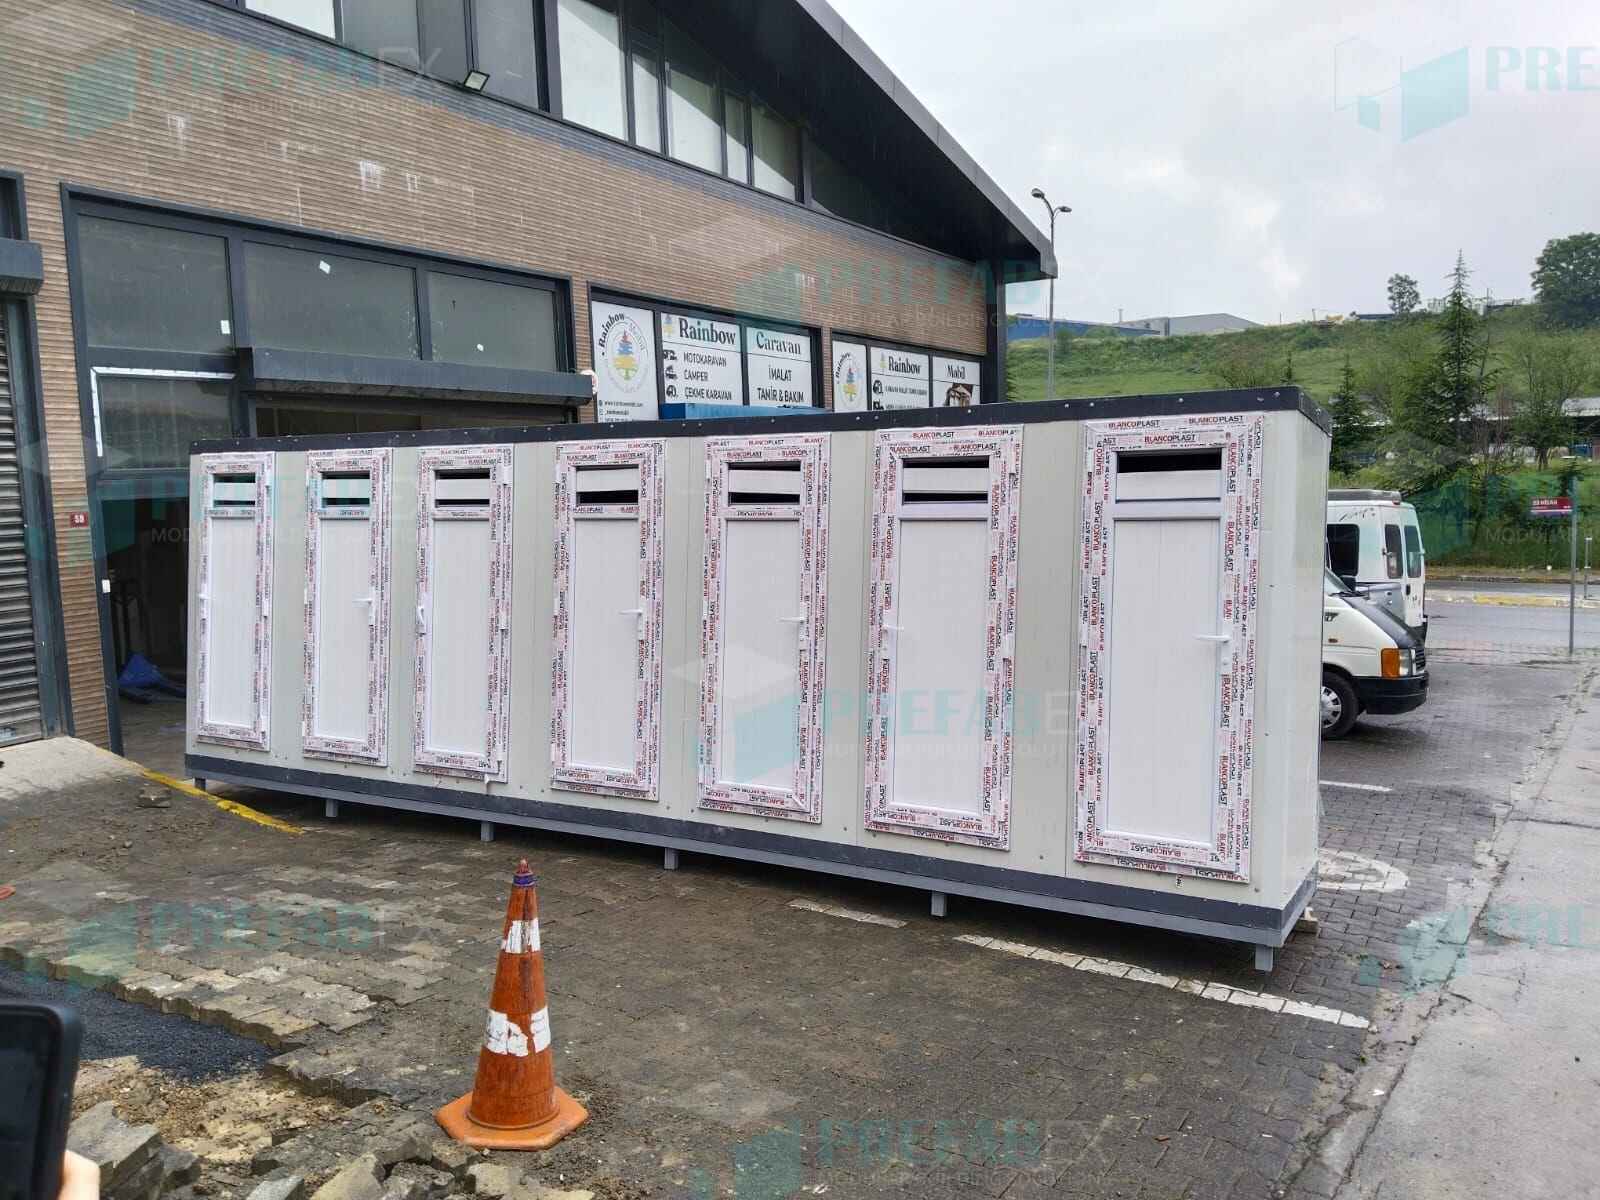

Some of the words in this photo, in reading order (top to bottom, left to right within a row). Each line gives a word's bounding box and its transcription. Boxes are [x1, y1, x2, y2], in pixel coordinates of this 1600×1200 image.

[679, 318, 736, 345] Rainbow
[756, 331, 801, 355] Caravan
[888, 357, 920, 374] Rainbow
[947, 364, 965, 379] Mobil
[1109, 420, 1160, 428] BLANCOPLAST
[1189, 415, 1244, 424] BLANCOPLAST
[1144, 434, 1196, 443] BLANCOPLAST
[1228, 442, 1236, 493] BLANCOPLAST
[1093, 501, 1102, 551] BLANCOPLAST
[1225, 521, 1234, 572] BLANCOPLAST
[1091, 576, 1099, 626] BLANCOPLAST
[987, 626, 995, 671] BLANCOPLAST
[1089, 651, 1097, 700] BLANCOPLAST
[1220, 677, 1230, 728] BLANCOPLAST
[1219, 755, 1228, 806] BLANCOPLAST
